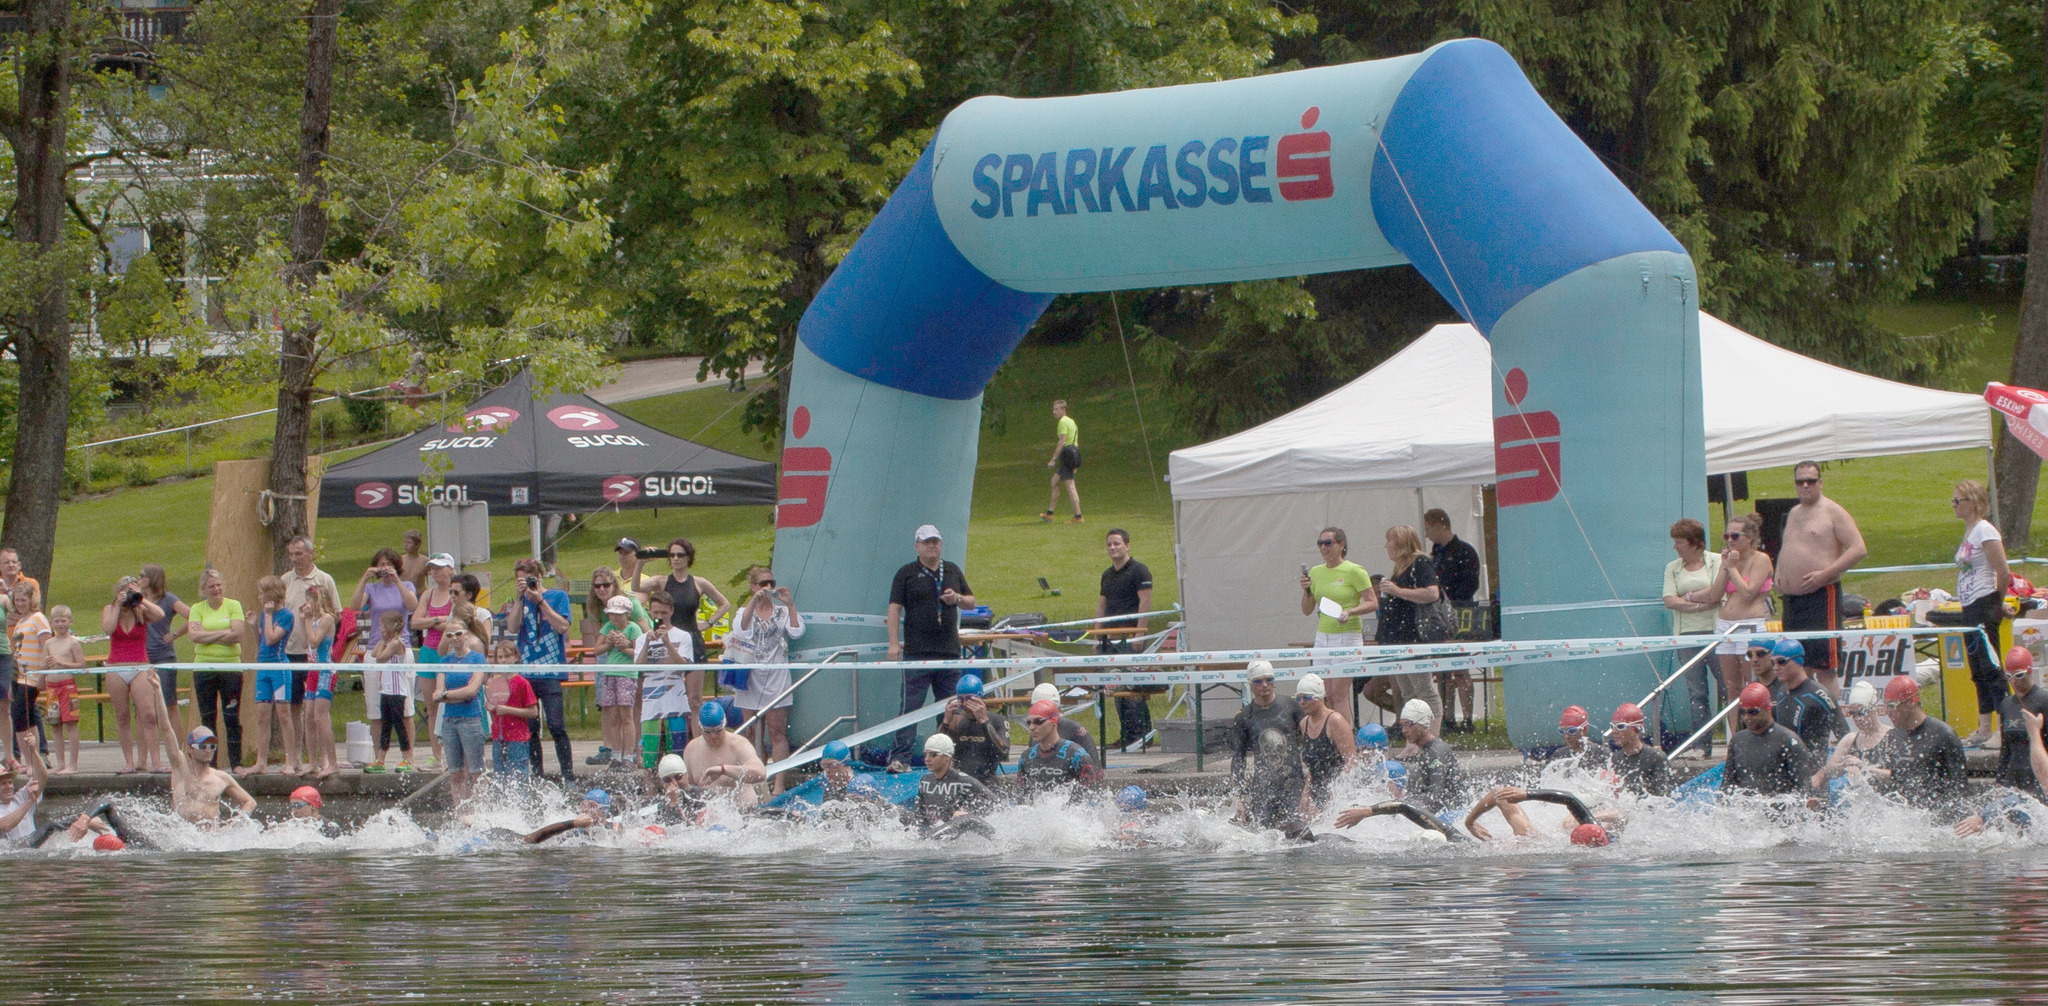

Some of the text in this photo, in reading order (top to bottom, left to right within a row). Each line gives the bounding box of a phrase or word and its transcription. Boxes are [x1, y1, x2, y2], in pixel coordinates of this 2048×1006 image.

[970, 135, 1274, 219] SPARKASSE
[1996, 396, 2025, 415] ESKIMO
[567, 434, 647, 448] SUGOi
[645, 476, 714, 496] SUGOi
